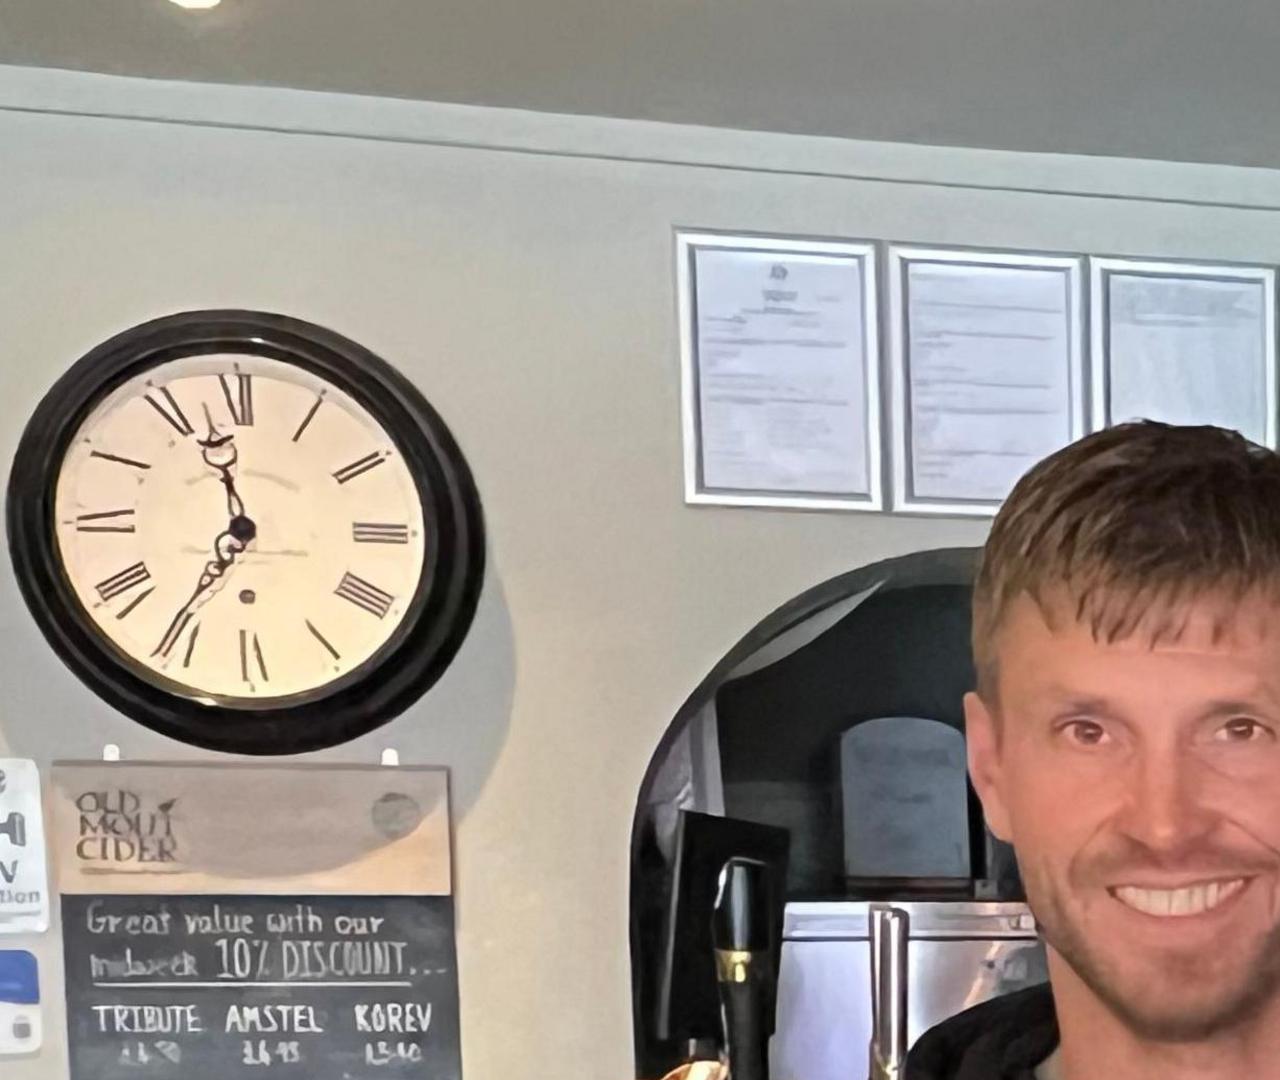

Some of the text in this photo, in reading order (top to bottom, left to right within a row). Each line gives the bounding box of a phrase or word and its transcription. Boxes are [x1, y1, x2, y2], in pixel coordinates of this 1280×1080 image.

[76, 789, 140, 814] OLD
[76, 836, 177, 864] CIDER
[86, 900, 386, 936] Great value with our
[215, 937, 270, 981] 10%
[92, 1002, 432, 1033] TRIBUTE AMSTEL KOREV
